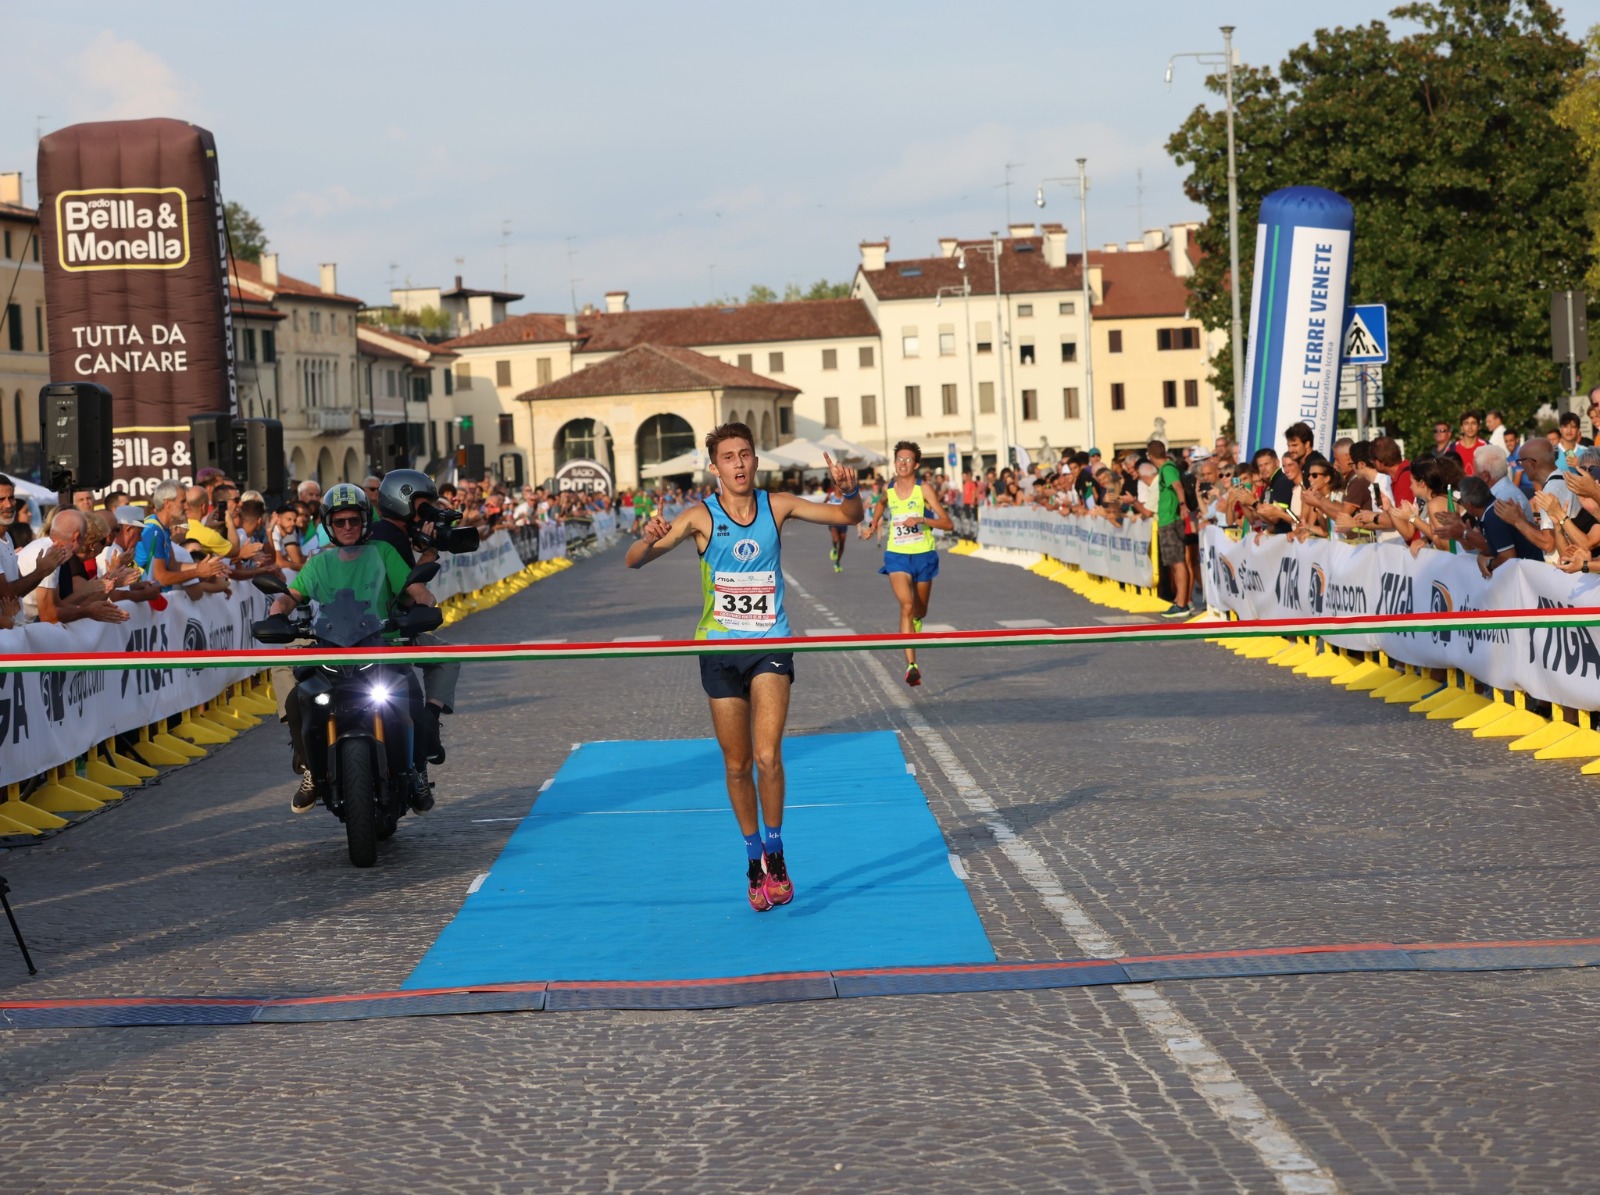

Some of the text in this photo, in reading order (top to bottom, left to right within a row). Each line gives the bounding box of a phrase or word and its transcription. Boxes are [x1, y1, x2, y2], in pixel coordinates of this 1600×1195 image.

[88, 198, 111, 209] radio
[157, 202, 178, 229] &
[67, 230, 182, 262] Monella
[1309, 243, 1332, 312] VENETE
[72, 323, 187, 348] TUTTA DA
[1304, 317, 1326, 375] TERRE
[74, 350, 188, 375] CANTARE
[1320, 369, 1332, 421] Cooperativo
[112, 437, 168, 467] ellla
[1317, 423, 1327, 457] ncario
[722, 594, 768, 614] 334
[1529, 594, 1600, 681] STIGA
